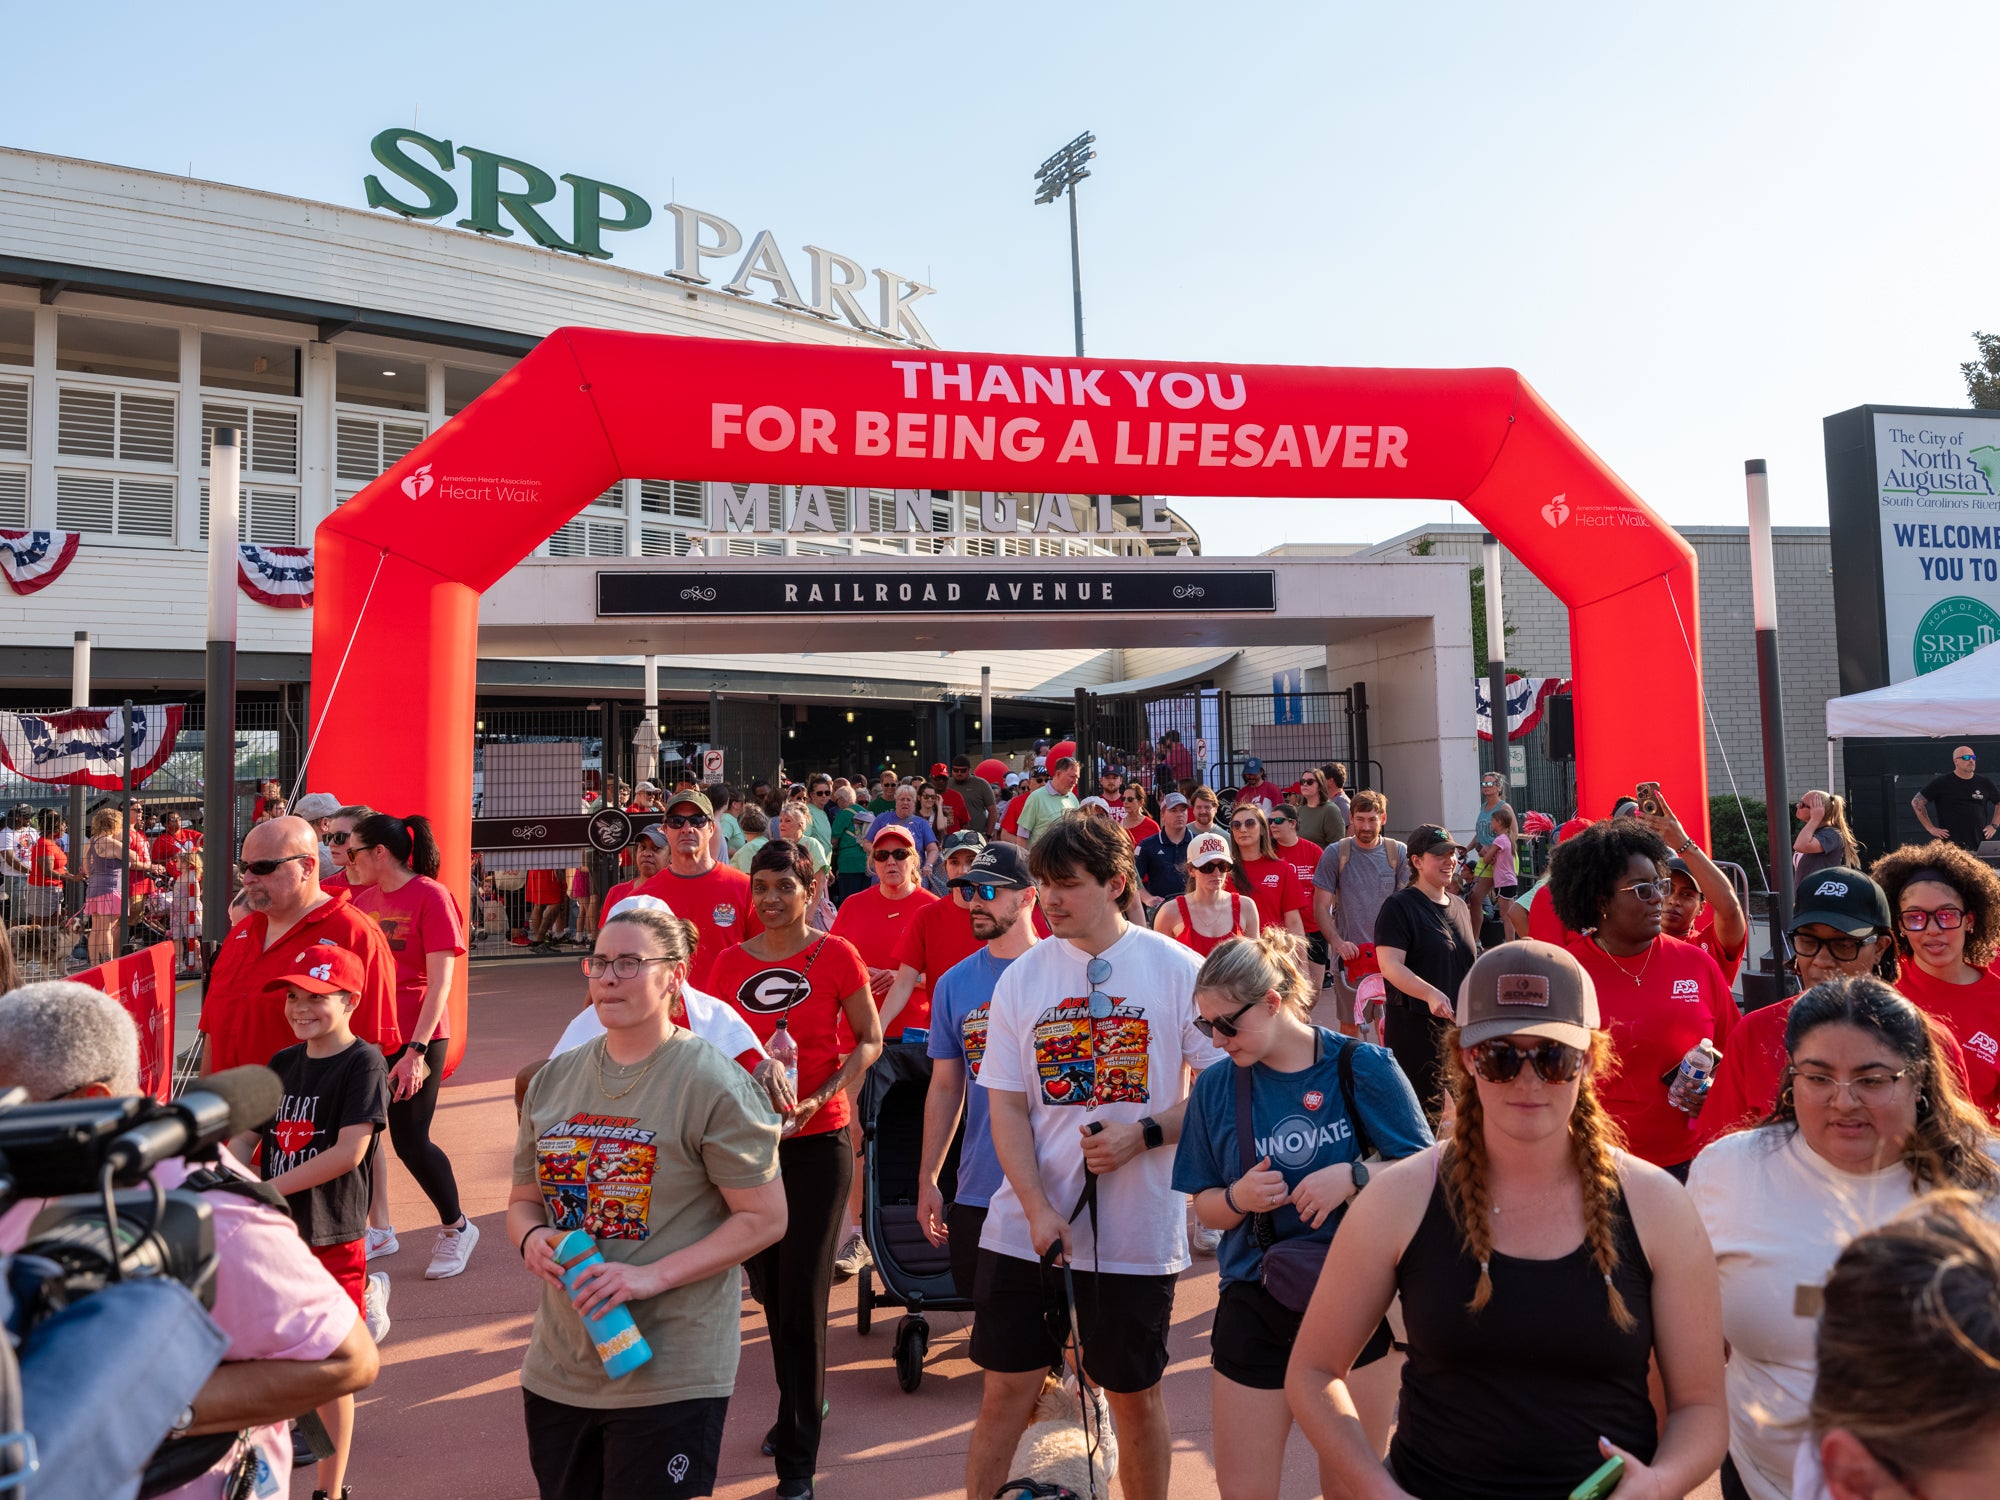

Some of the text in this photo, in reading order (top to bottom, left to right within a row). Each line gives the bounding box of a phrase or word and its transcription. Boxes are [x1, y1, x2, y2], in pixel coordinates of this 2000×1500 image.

[363, 127, 941, 350] SRP PARK
[892, 360, 1247, 411] THANK YOU
[711, 402, 1409, 469] FOR BEING A LIFESAVER
[1888, 428, 1964, 449] The City of
[1901, 448, 1962, 470] North
[441, 475, 477, 483] American
[477, 476, 499, 484] Heart
[1884, 468, 1978, 497] Augusta
[439, 484, 492, 501] Heart
[1881, 496, 1914, 508] South
[1916, 497, 1969, 509] Carolina's
[710, 482, 933, 534] MAIN
[1575, 513, 1614, 527] Heart
[1918, 556, 1998, 582] YOU TO
[783, 582, 1115, 603] RAILROAD AVENUE
[1928, 603, 1995, 627] HOME OF THE
[1921, 634, 1974, 652] SRP
[1199, 844, 1225, 854] RANCH
[1202, 838, 1222, 846] ROSE
[1814, 881, 1848, 897] ADP
[736, 967, 812, 1014] G
[1673, 979, 1699, 994] ADP
[1057, 996, 1127, 1010] ARTY
[1036, 1005, 1145, 1025] AVENRS
[1968, 1031, 1998, 1056] ADP
[275, 1094, 320, 1123] HEART
[567, 1112, 640, 1127] ARTERY
[541, 1120, 656, 1144] AVENGERS
[1255, 1118, 1352, 1157] NNOVATE
